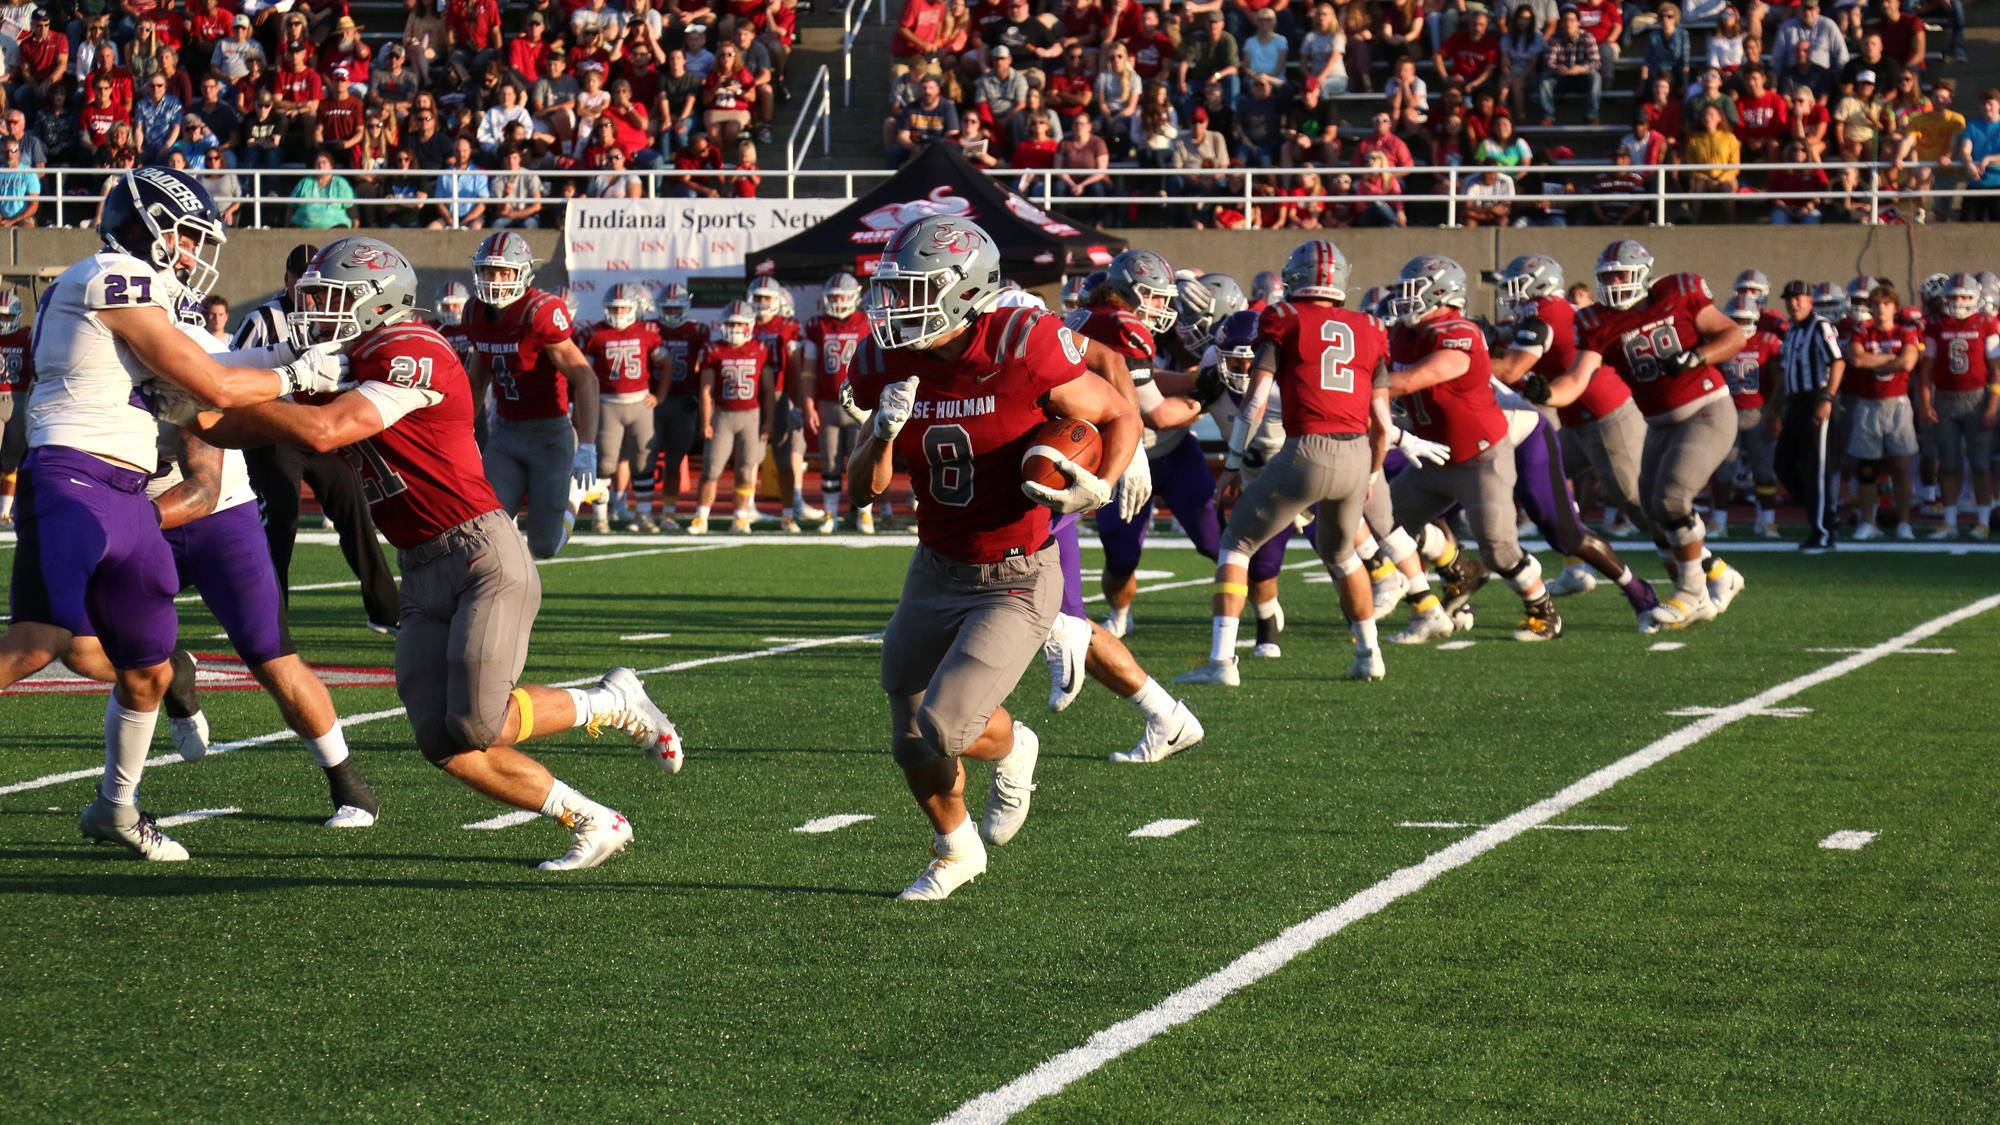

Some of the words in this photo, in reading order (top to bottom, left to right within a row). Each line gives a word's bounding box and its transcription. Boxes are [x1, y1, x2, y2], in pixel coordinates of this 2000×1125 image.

[138, 167, 204, 212] RAIDERS
[578, 209, 667, 229] Indiana
[681, 207, 756, 233] Sports
[571, 241, 594, 252] ISN
[641, 240, 665, 252] ISN
[711, 241, 736, 253] ISN
[606, 260, 630, 271] ISN
[675, 257, 700, 269] ISN
[104, 274, 152, 304] 27
[571, 280, 595, 292] ISN
[553, 307, 569, 331] 4
[1057, 326, 1082, 365] 8
[1321, 320, 1355, 394] 2
[1949, 339, 1969, 374] 6
[387, 355, 433, 389] 21
[492, 354, 520, 400] 4
[605, 346, 641, 380] 75
[721, 365, 757, 400] 25
[910, 395, 995, 419] SE-HULMAN
[922, 423, 975, 507] 8
[1009, 548, 1019, 556] M
